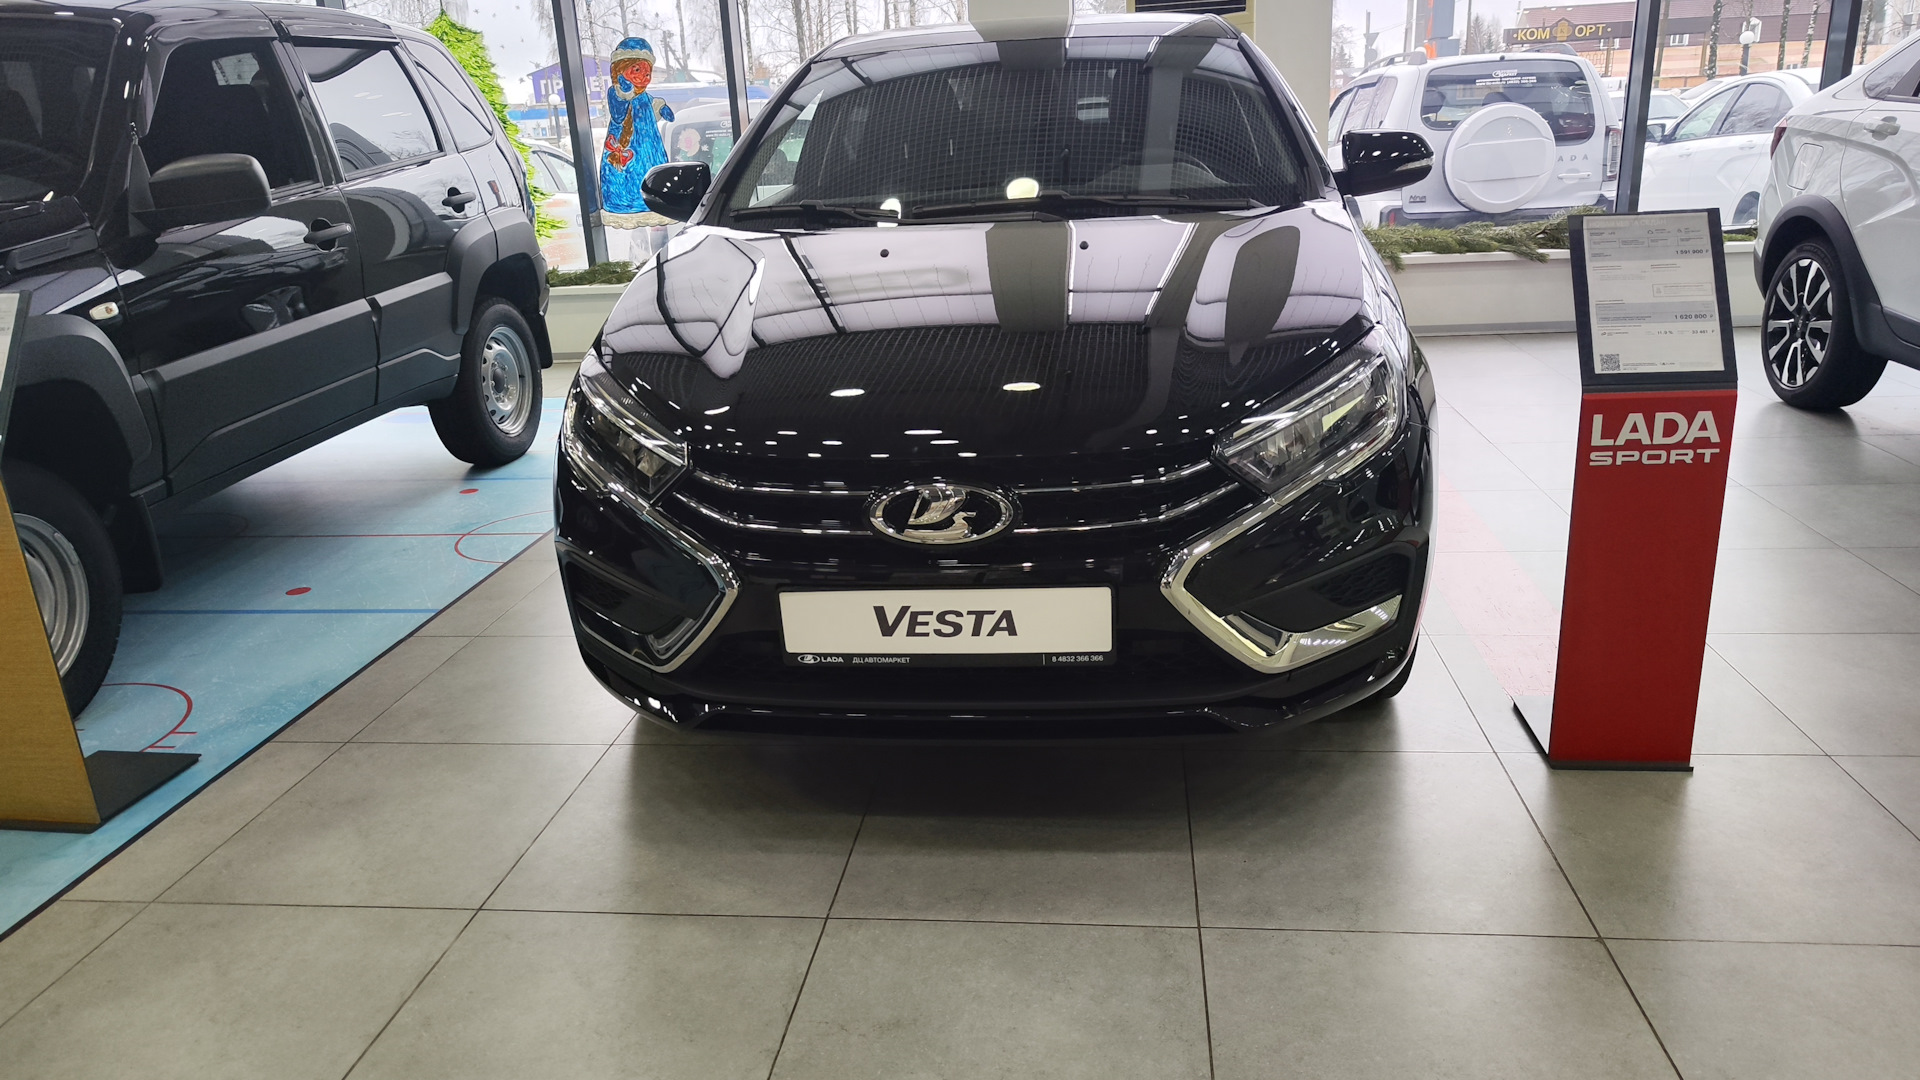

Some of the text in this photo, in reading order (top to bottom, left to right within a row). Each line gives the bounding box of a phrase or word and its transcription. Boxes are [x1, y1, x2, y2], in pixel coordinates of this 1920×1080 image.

[1557, 153, 1589, 162] ADA
[1591, 410, 1721, 446] LADA
[1589, 448, 1720, 466] SPORT
[873, 605, 1018, 638] VESTA
